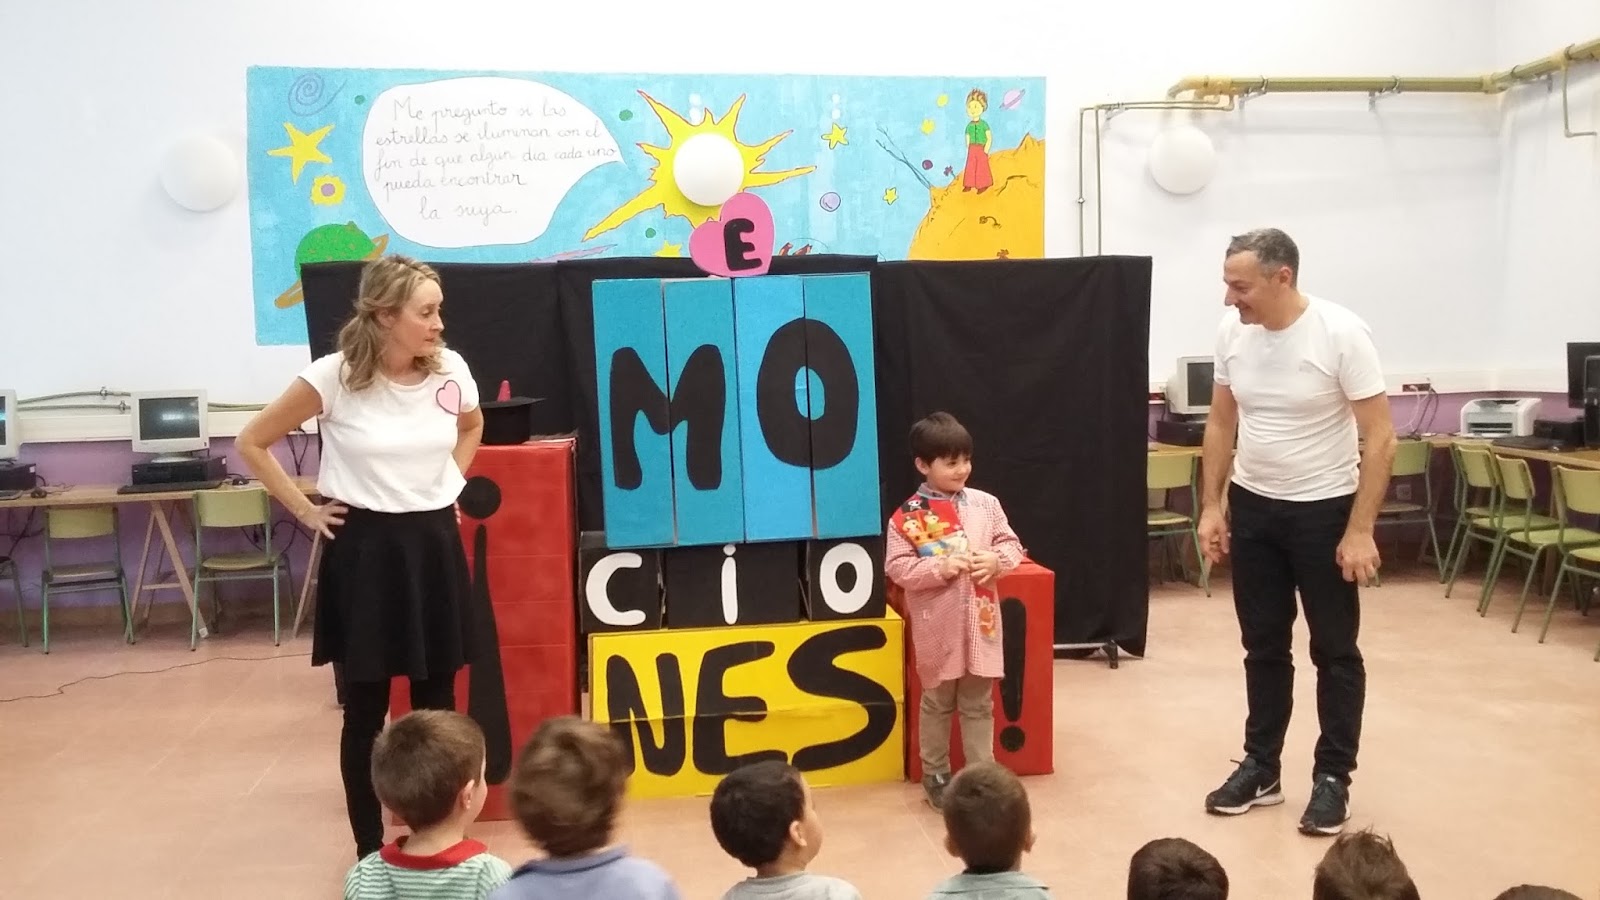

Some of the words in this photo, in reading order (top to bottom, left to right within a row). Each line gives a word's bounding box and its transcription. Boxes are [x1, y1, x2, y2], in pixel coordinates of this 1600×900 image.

[393, 95, 424, 121] Me
[431, 99, 508, 134] pregunto
[518, 106, 533, 117] si
[542, 96, 567, 117] las
[376, 127, 449, 146] estrellas
[454, 132, 470, 143] se
[477, 121, 551, 140] iluminan
[557, 128, 582, 138] con
[374, 148, 403, 182] fin
[410, 146, 428, 167] de
[434, 154, 464, 176] que
[554, 146, 584, 160] cada
[587, 148, 617, 157] uno
[383, 170, 434, 203] pueda
[440, 172, 528, 188] encontrar
[419, 195, 441, 220] la
[456, 204, 518, 227] suya.
[722, 217, 763, 271] E
[611, 317, 859, 490] MO
[607, 625, 897, 776] NES
